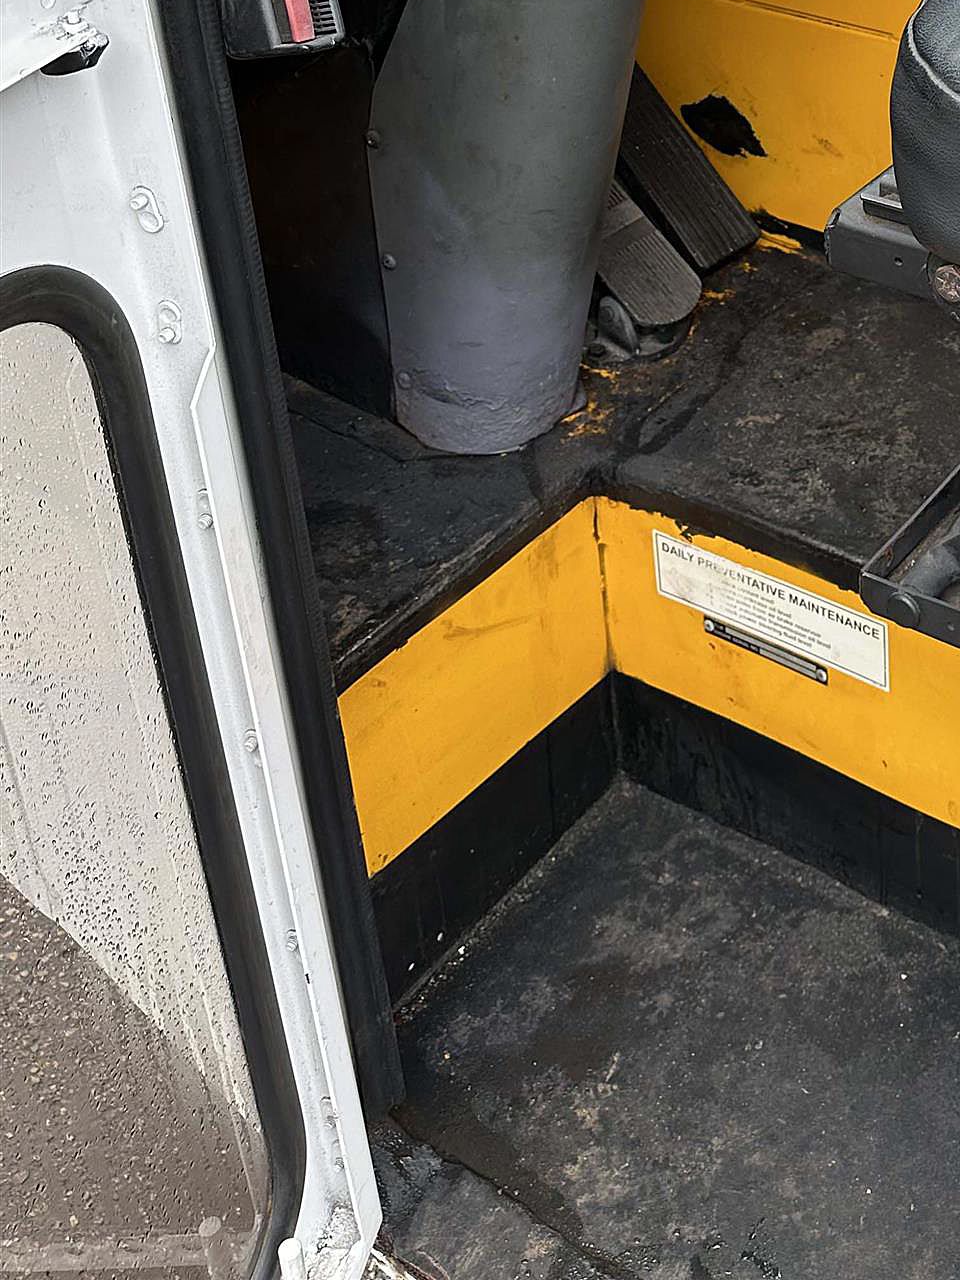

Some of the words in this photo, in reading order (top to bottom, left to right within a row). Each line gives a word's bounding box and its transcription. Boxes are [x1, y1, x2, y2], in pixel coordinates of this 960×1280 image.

[661, 542, 694, 562] DAILY
[698, 558, 786, 601] PREVENTATIVE
[789, 593, 880, 639] MAINTENANCE
